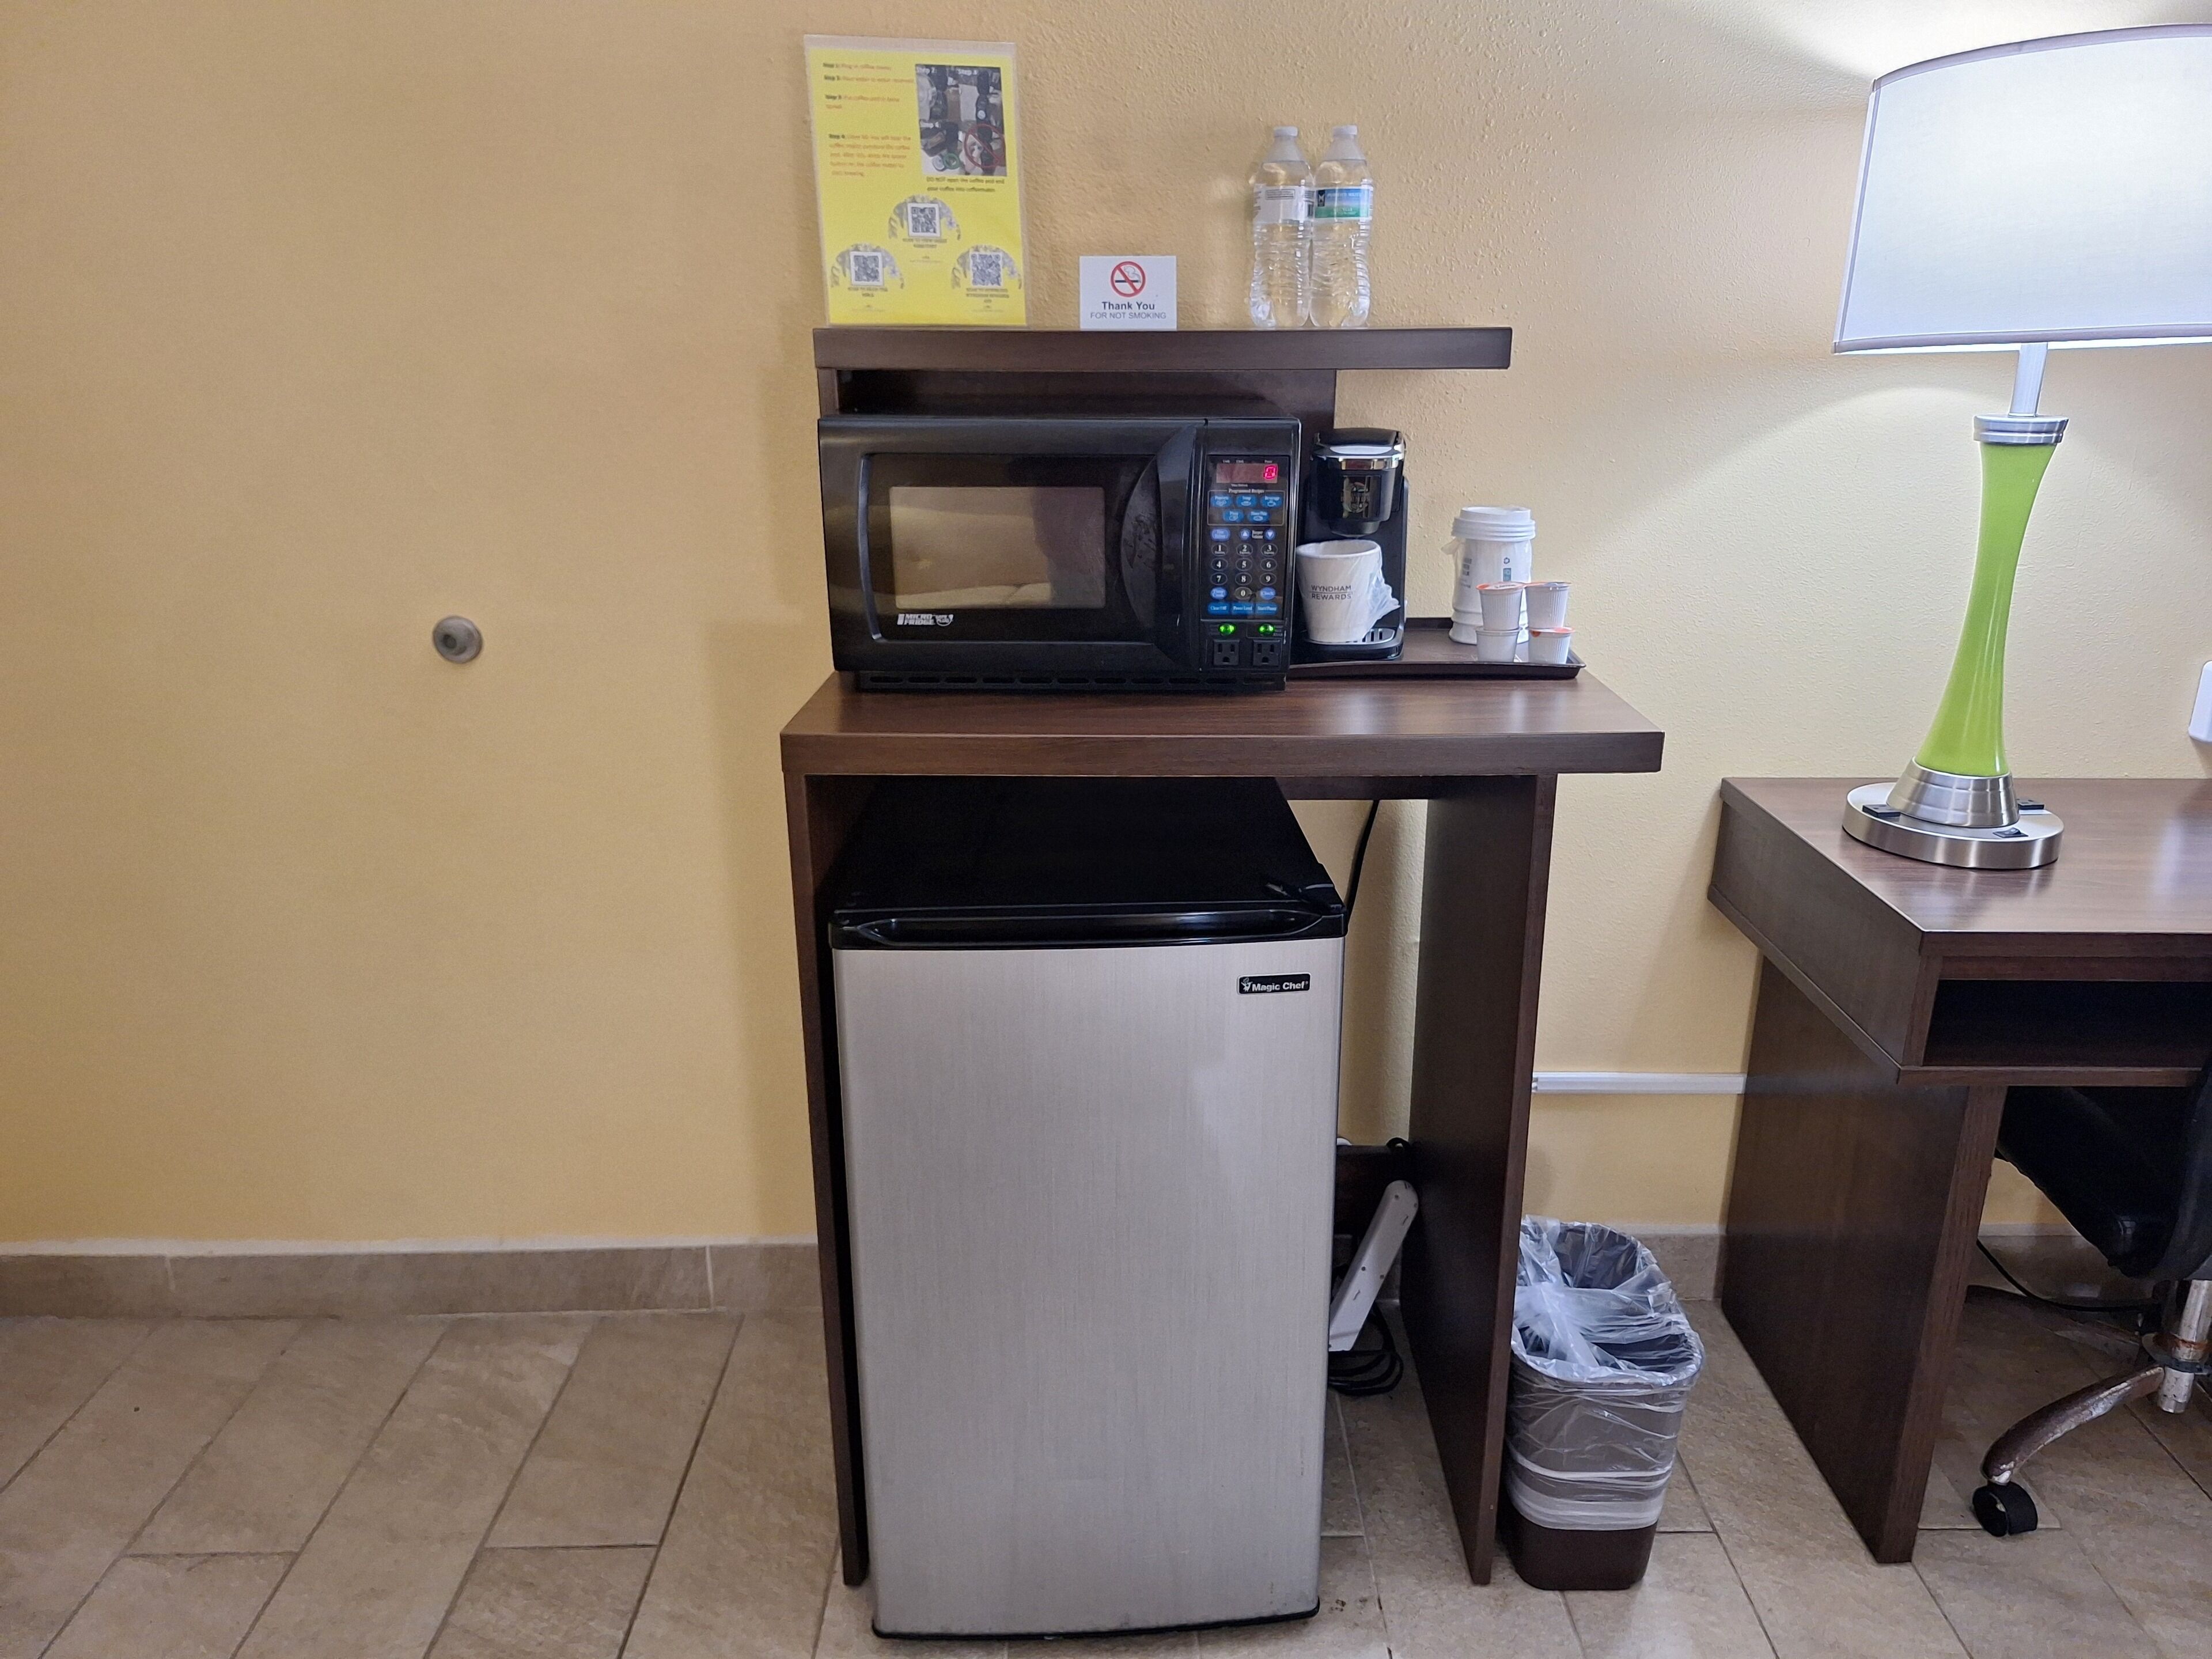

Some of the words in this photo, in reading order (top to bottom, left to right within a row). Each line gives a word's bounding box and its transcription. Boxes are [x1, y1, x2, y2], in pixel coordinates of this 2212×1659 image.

[1101, 301, 1132, 310] Thank
[1136, 301, 1155, 310] You
[1252, 983, 1281, 992] Magic
